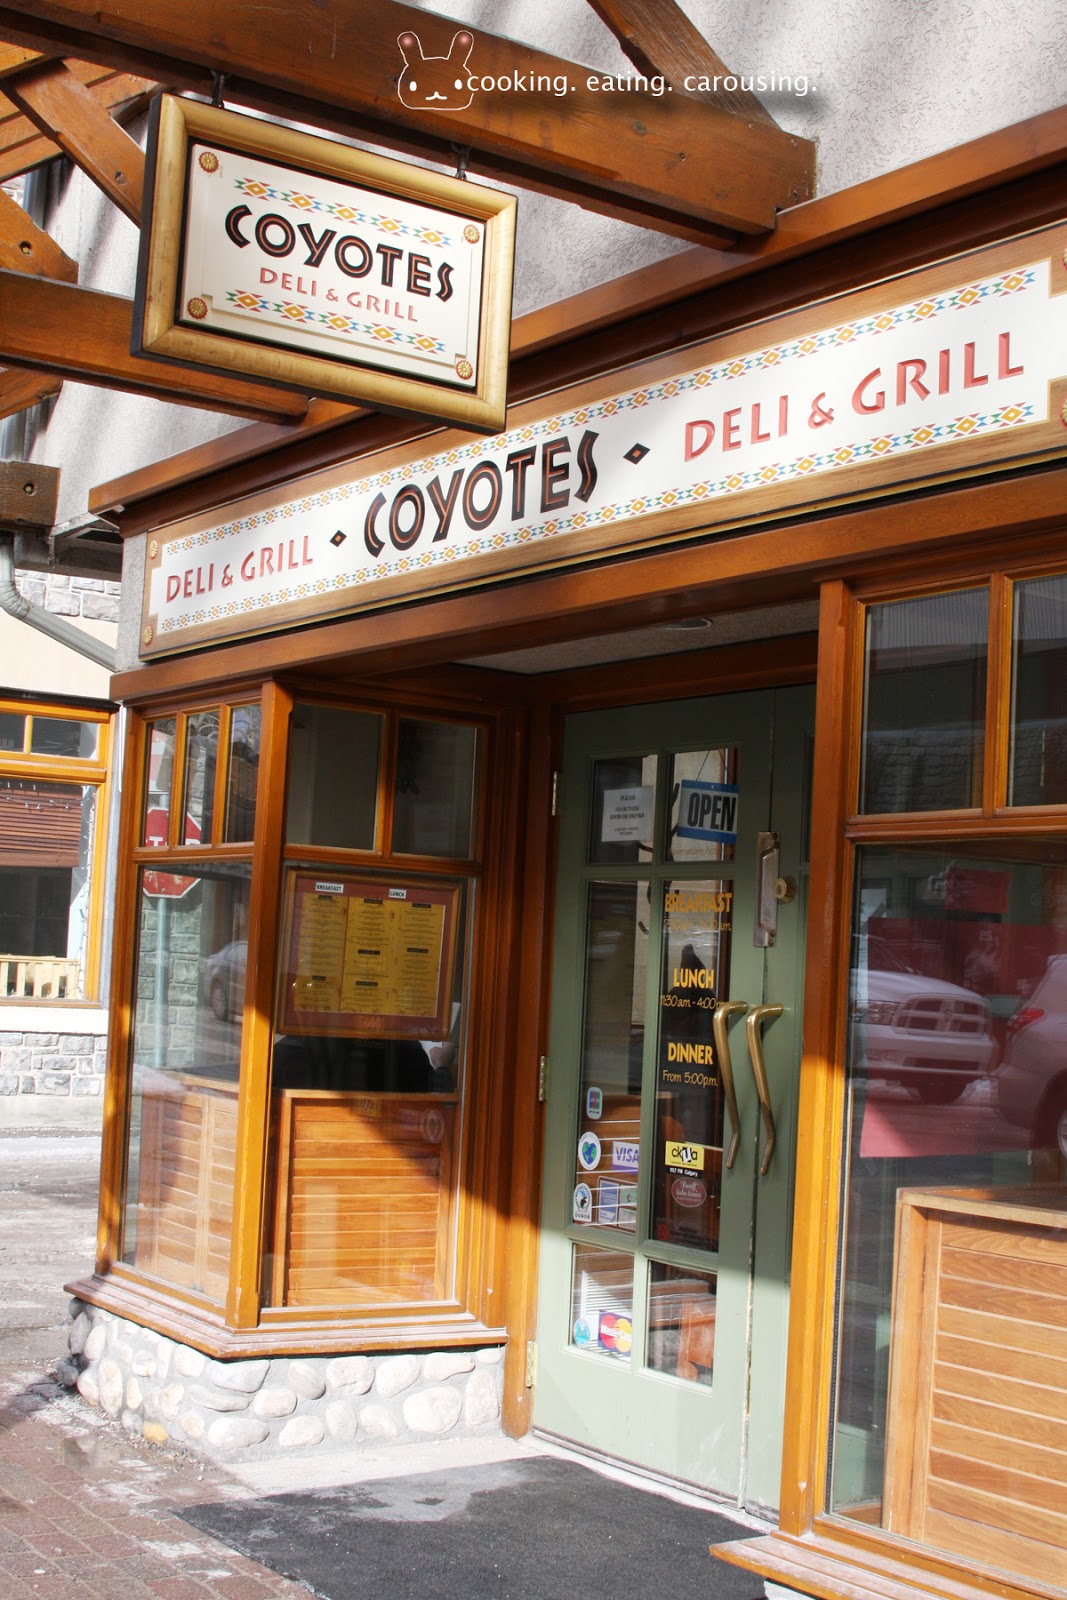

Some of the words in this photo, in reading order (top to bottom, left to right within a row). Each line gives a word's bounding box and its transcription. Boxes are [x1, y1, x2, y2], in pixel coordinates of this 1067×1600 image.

[224, 204, 456, 303] COYOTES
[259, 267, 319, 298] DELI
[326, 287, 339, 302] &
[346, 291, 419, 323] GRILL
[166, 563, 214, 604] DELI
[221, 567, 234, 589] &
[240, 535, 314, 583] GRILL
[363, 429, 599, 558] COYOTES
[683, 395, 789, 463] DELI
[807, 392, 835, 430] &
[851, 331, 1024, 417] GRILL
[687, 792, 736, 831] OPEN
[664, 892, 733, 913] BREAKFAST
[673, 967, 715, 989] LUNCH
[667, 1042, 714, 1066] DINNER
[662, 1069, 681, 1083] From
[615, 1146, 639, 1163] VISA
